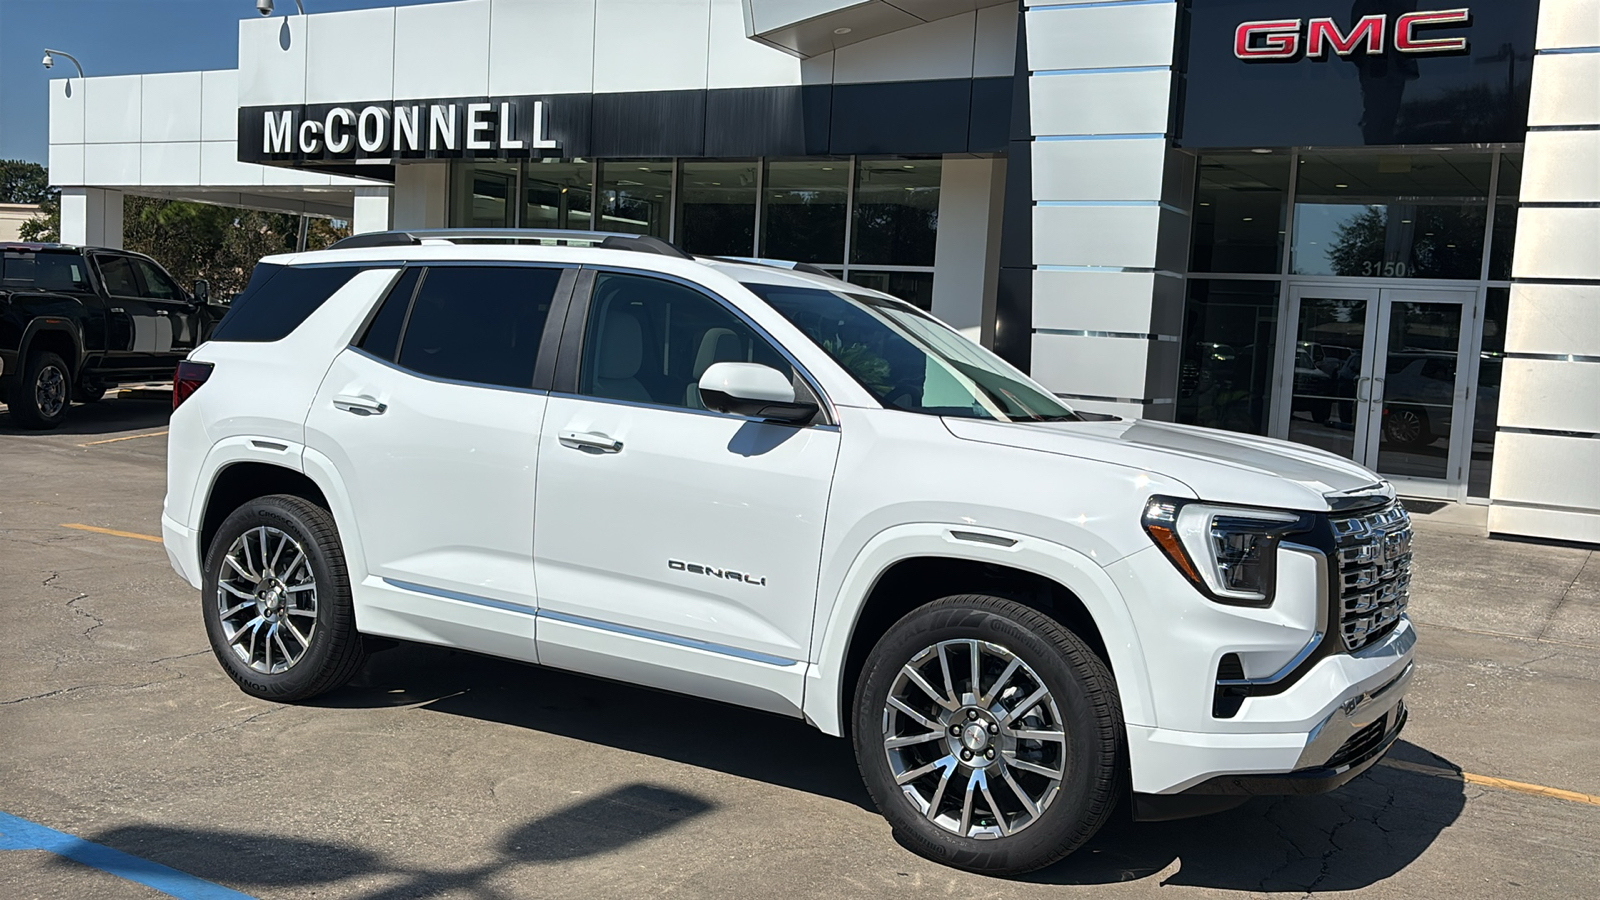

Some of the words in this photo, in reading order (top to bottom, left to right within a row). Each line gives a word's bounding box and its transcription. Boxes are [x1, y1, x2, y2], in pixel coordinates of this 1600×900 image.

[1234, 8, 1469, 59] GMC
[263, 101, 559, 154] McCONNELL
[1361, 261, 1406, 277] 3150
[668, 559, 766, 587] DENALI
